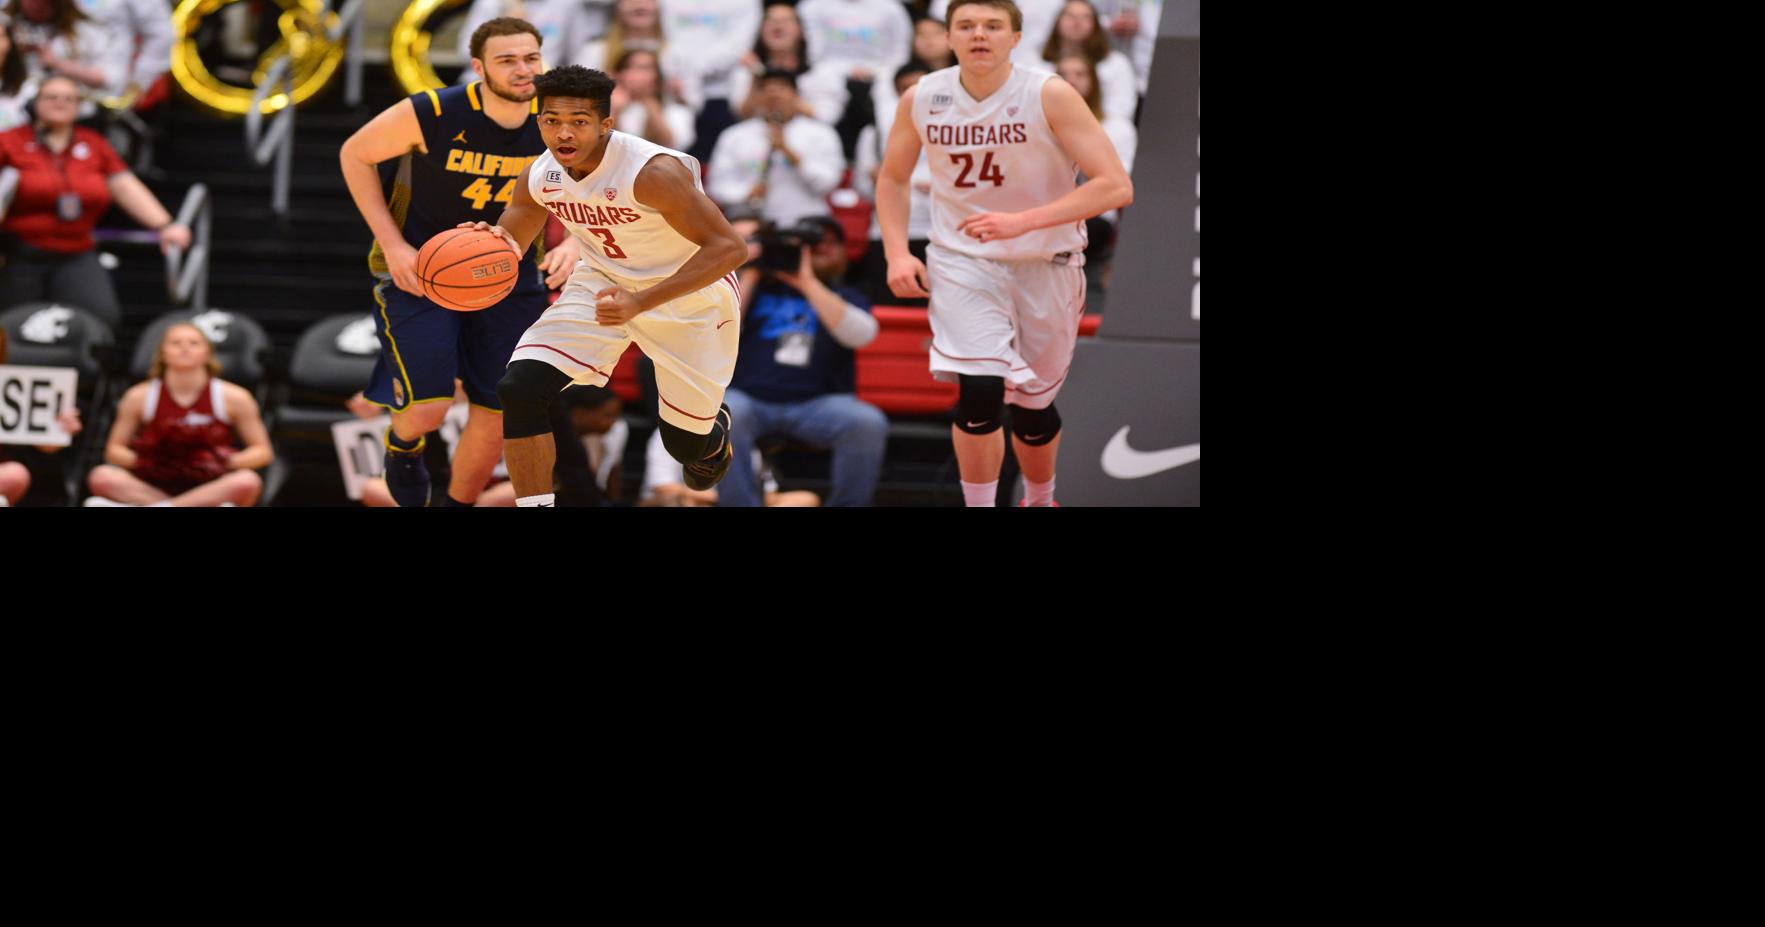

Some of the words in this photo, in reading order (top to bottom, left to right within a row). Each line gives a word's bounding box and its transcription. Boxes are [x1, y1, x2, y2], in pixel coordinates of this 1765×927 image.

[927, 122, 1027, 146] COUGARS
[948, 151, 1005, 188] 24
[462, 177, 517, 210] 44
[544, 201, 641, 227] COUGARS
[587, 227, 627, 259] 3
